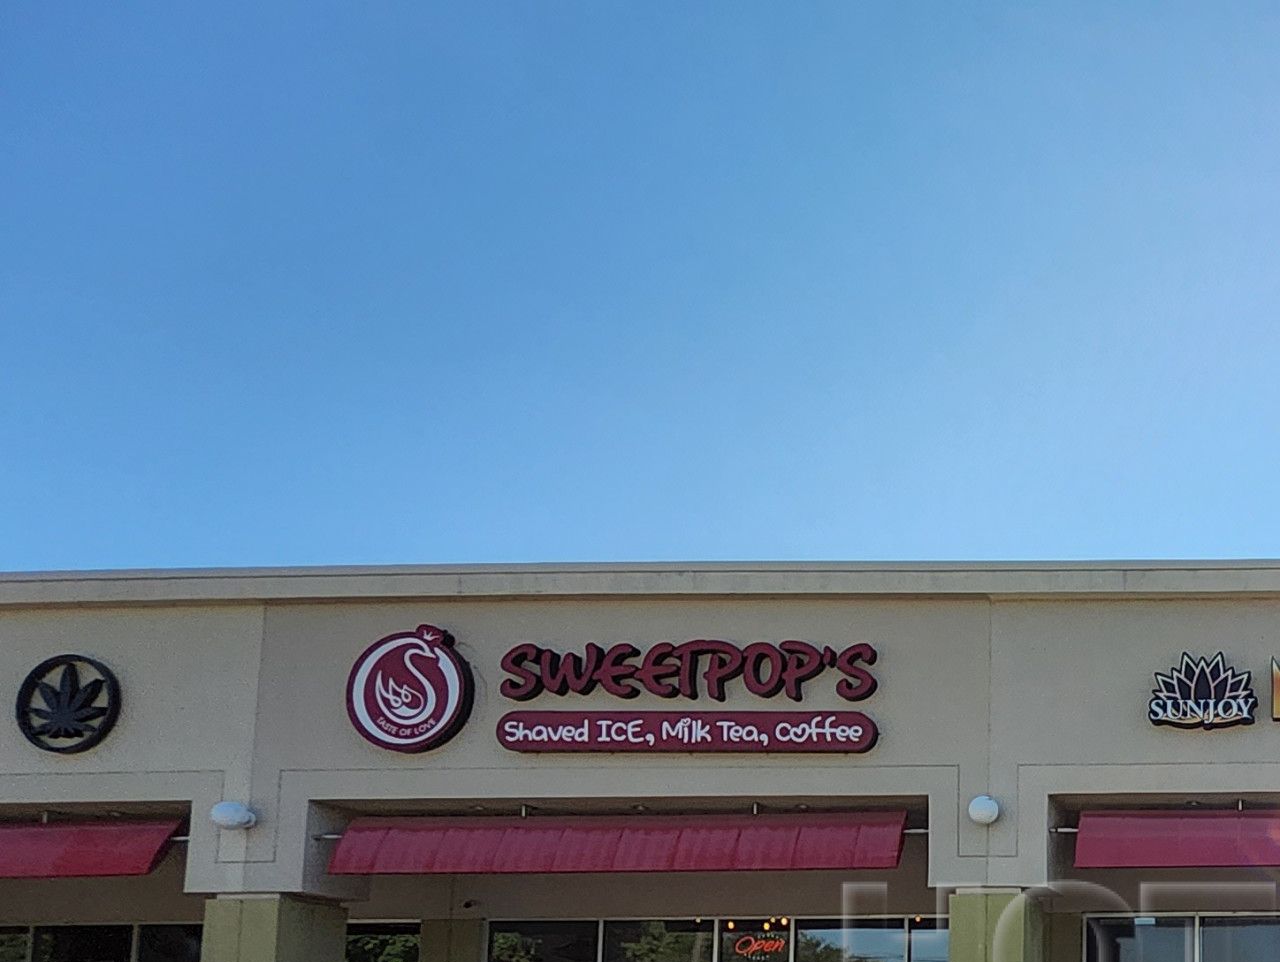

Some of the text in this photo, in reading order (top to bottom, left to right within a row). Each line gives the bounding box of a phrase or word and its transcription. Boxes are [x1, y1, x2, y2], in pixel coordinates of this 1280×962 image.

[1149, 698, 1256, 725] SUNJOY
[399, 728, 412, 736] OF
[413, 717, 436, 735] LOVE
[503, 718, 589, 743] Shaved
[597, 719, 655, 747] ICE,
[662, 716, 712, 744] Milk
[716, 720, 769, 747] Tea,
[734, 935, 786, 956] Open
